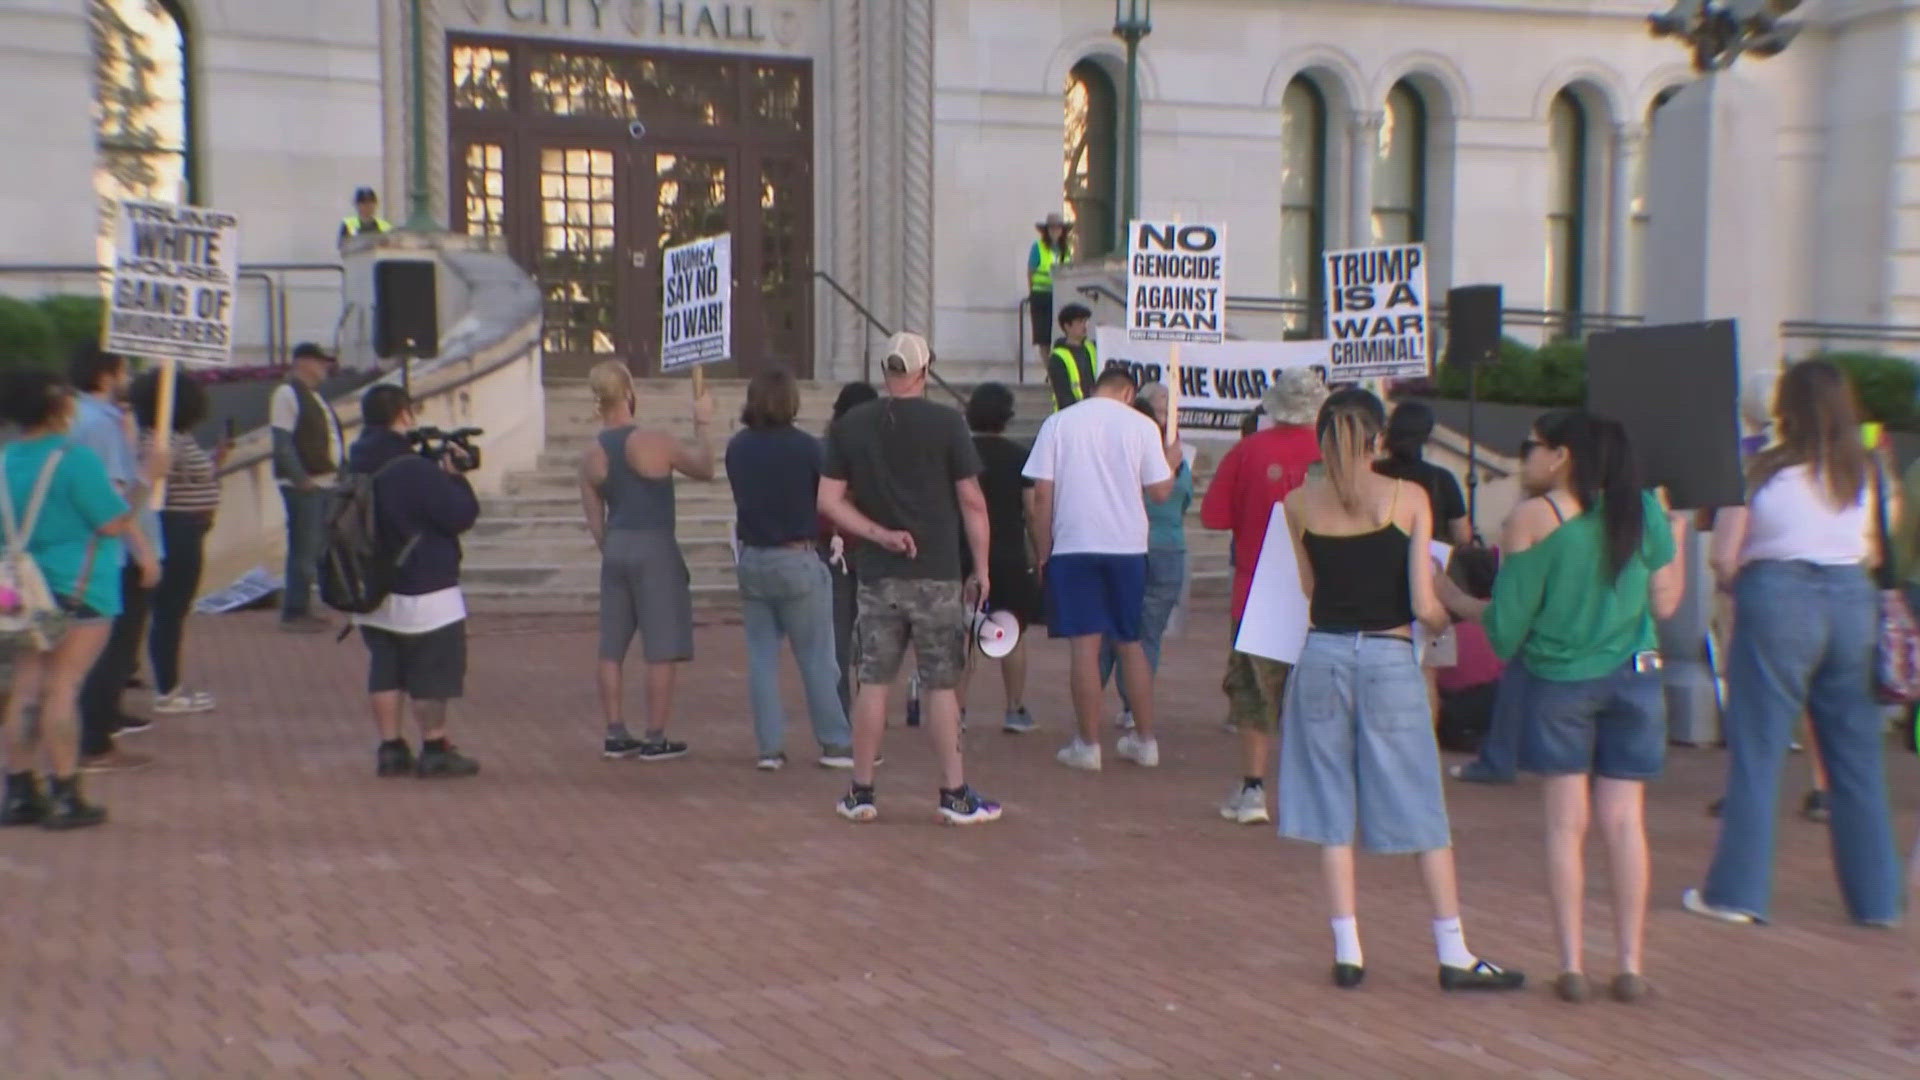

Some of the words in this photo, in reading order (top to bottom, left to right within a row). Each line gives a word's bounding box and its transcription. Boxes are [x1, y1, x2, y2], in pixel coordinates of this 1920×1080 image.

[656, 0, 768, 41] HALL
[134, 222, 221, 266] WHITE
[1138, 223, 1217, 252] NO
[671, 243, 716, 275] WOMEN
[1133, 252, 1221, 280] GENOCIDE
[1328, 248, 1421, 286] TRUMP
[115, 278, 187, 315] GANG
[196, 286, 231, 321] OF
[667, 269, 693, 308] SAY
[695, 264, 718, 300] NO
[1135, 285, 1218, 311] AGAINST
[1333, 285, 1376, 313] IS
[1385, 281, 1419, 309] A
[664, 311, 680, 345] TO
[683, 300, 723, 339] WAR!
[1135, 310, 1217, 331] IRAN
[1331, 314, 1423, 339] WAR
[1331, 336, 1424, 366] CRIMINAL!
[1166, 364, 1209, 397] HE
[1214, 367, 1268, 399] WAR
